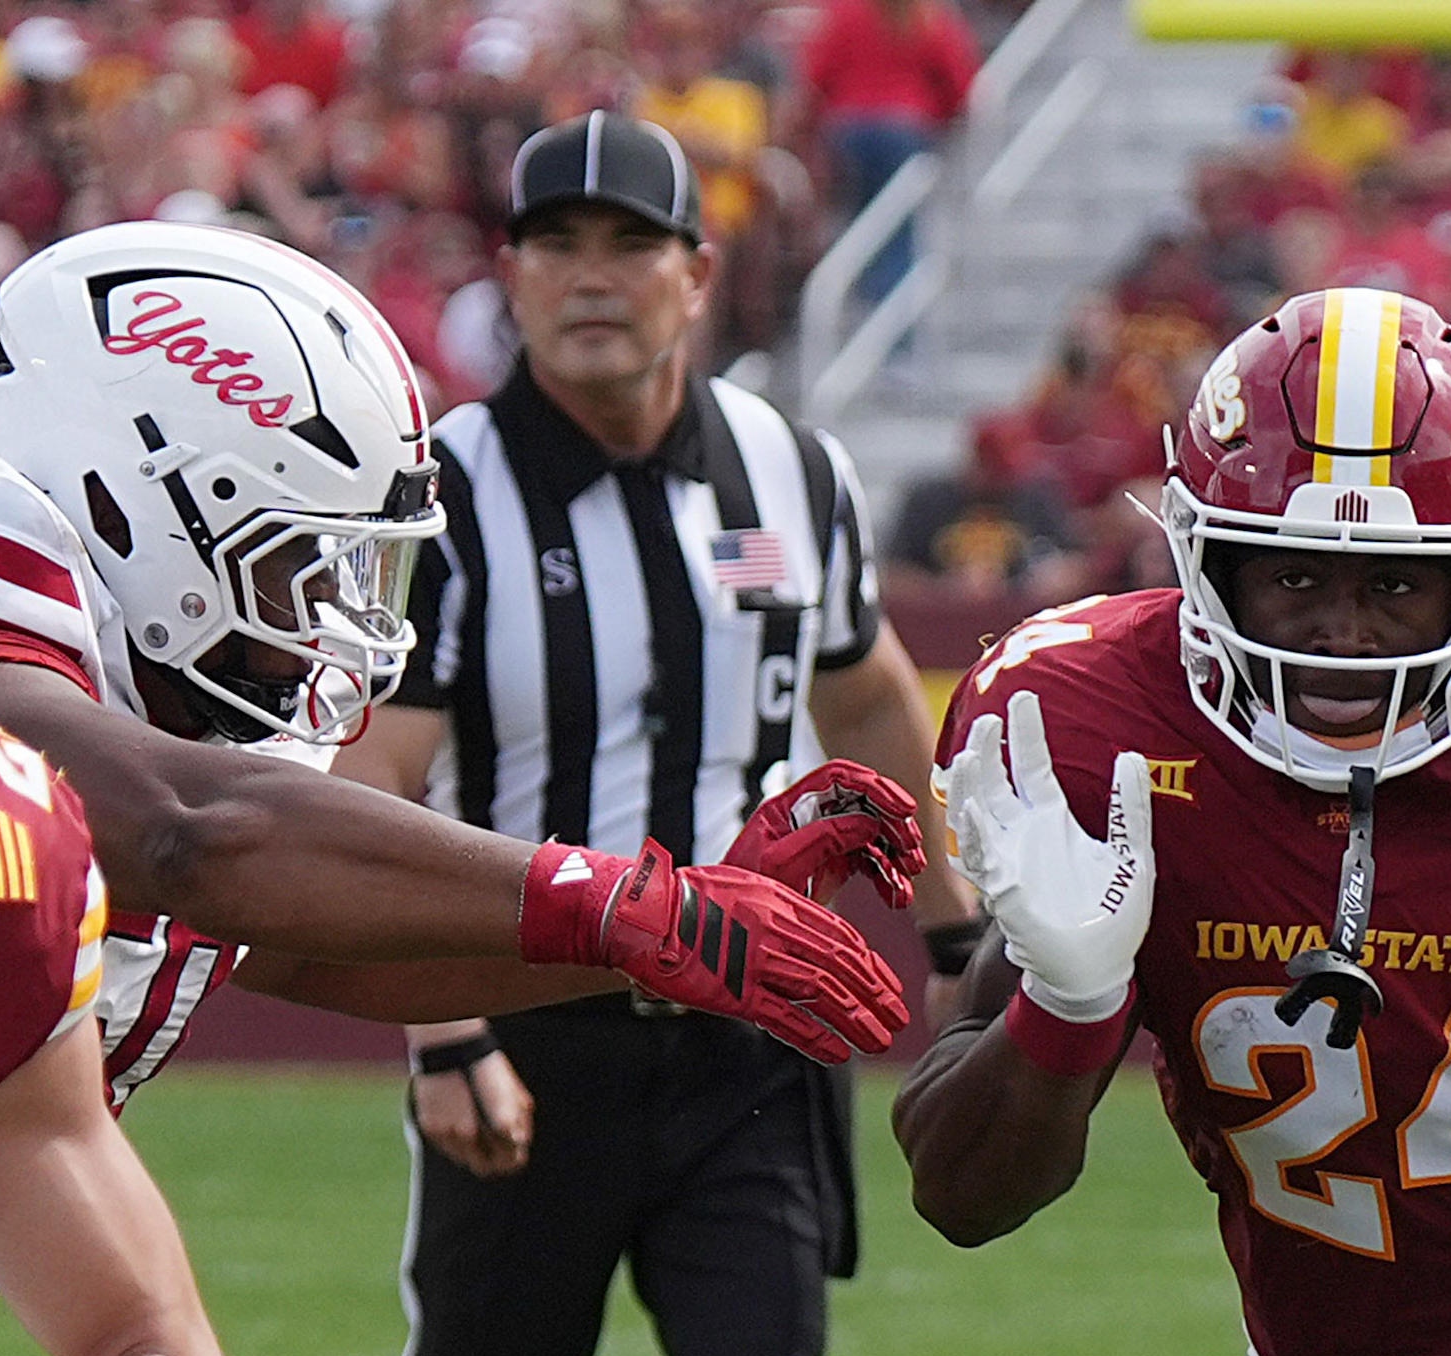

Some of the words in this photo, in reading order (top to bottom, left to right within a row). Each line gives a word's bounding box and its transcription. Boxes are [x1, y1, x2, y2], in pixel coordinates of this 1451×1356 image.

[105, 291, 295, 428] Yotes
[540, 547, 579, 597] S
[758, 655, 795, 722] C
[1195, 919, 1331, 963] IOWA
[1340, 872, 1366, 953] RIVEL
